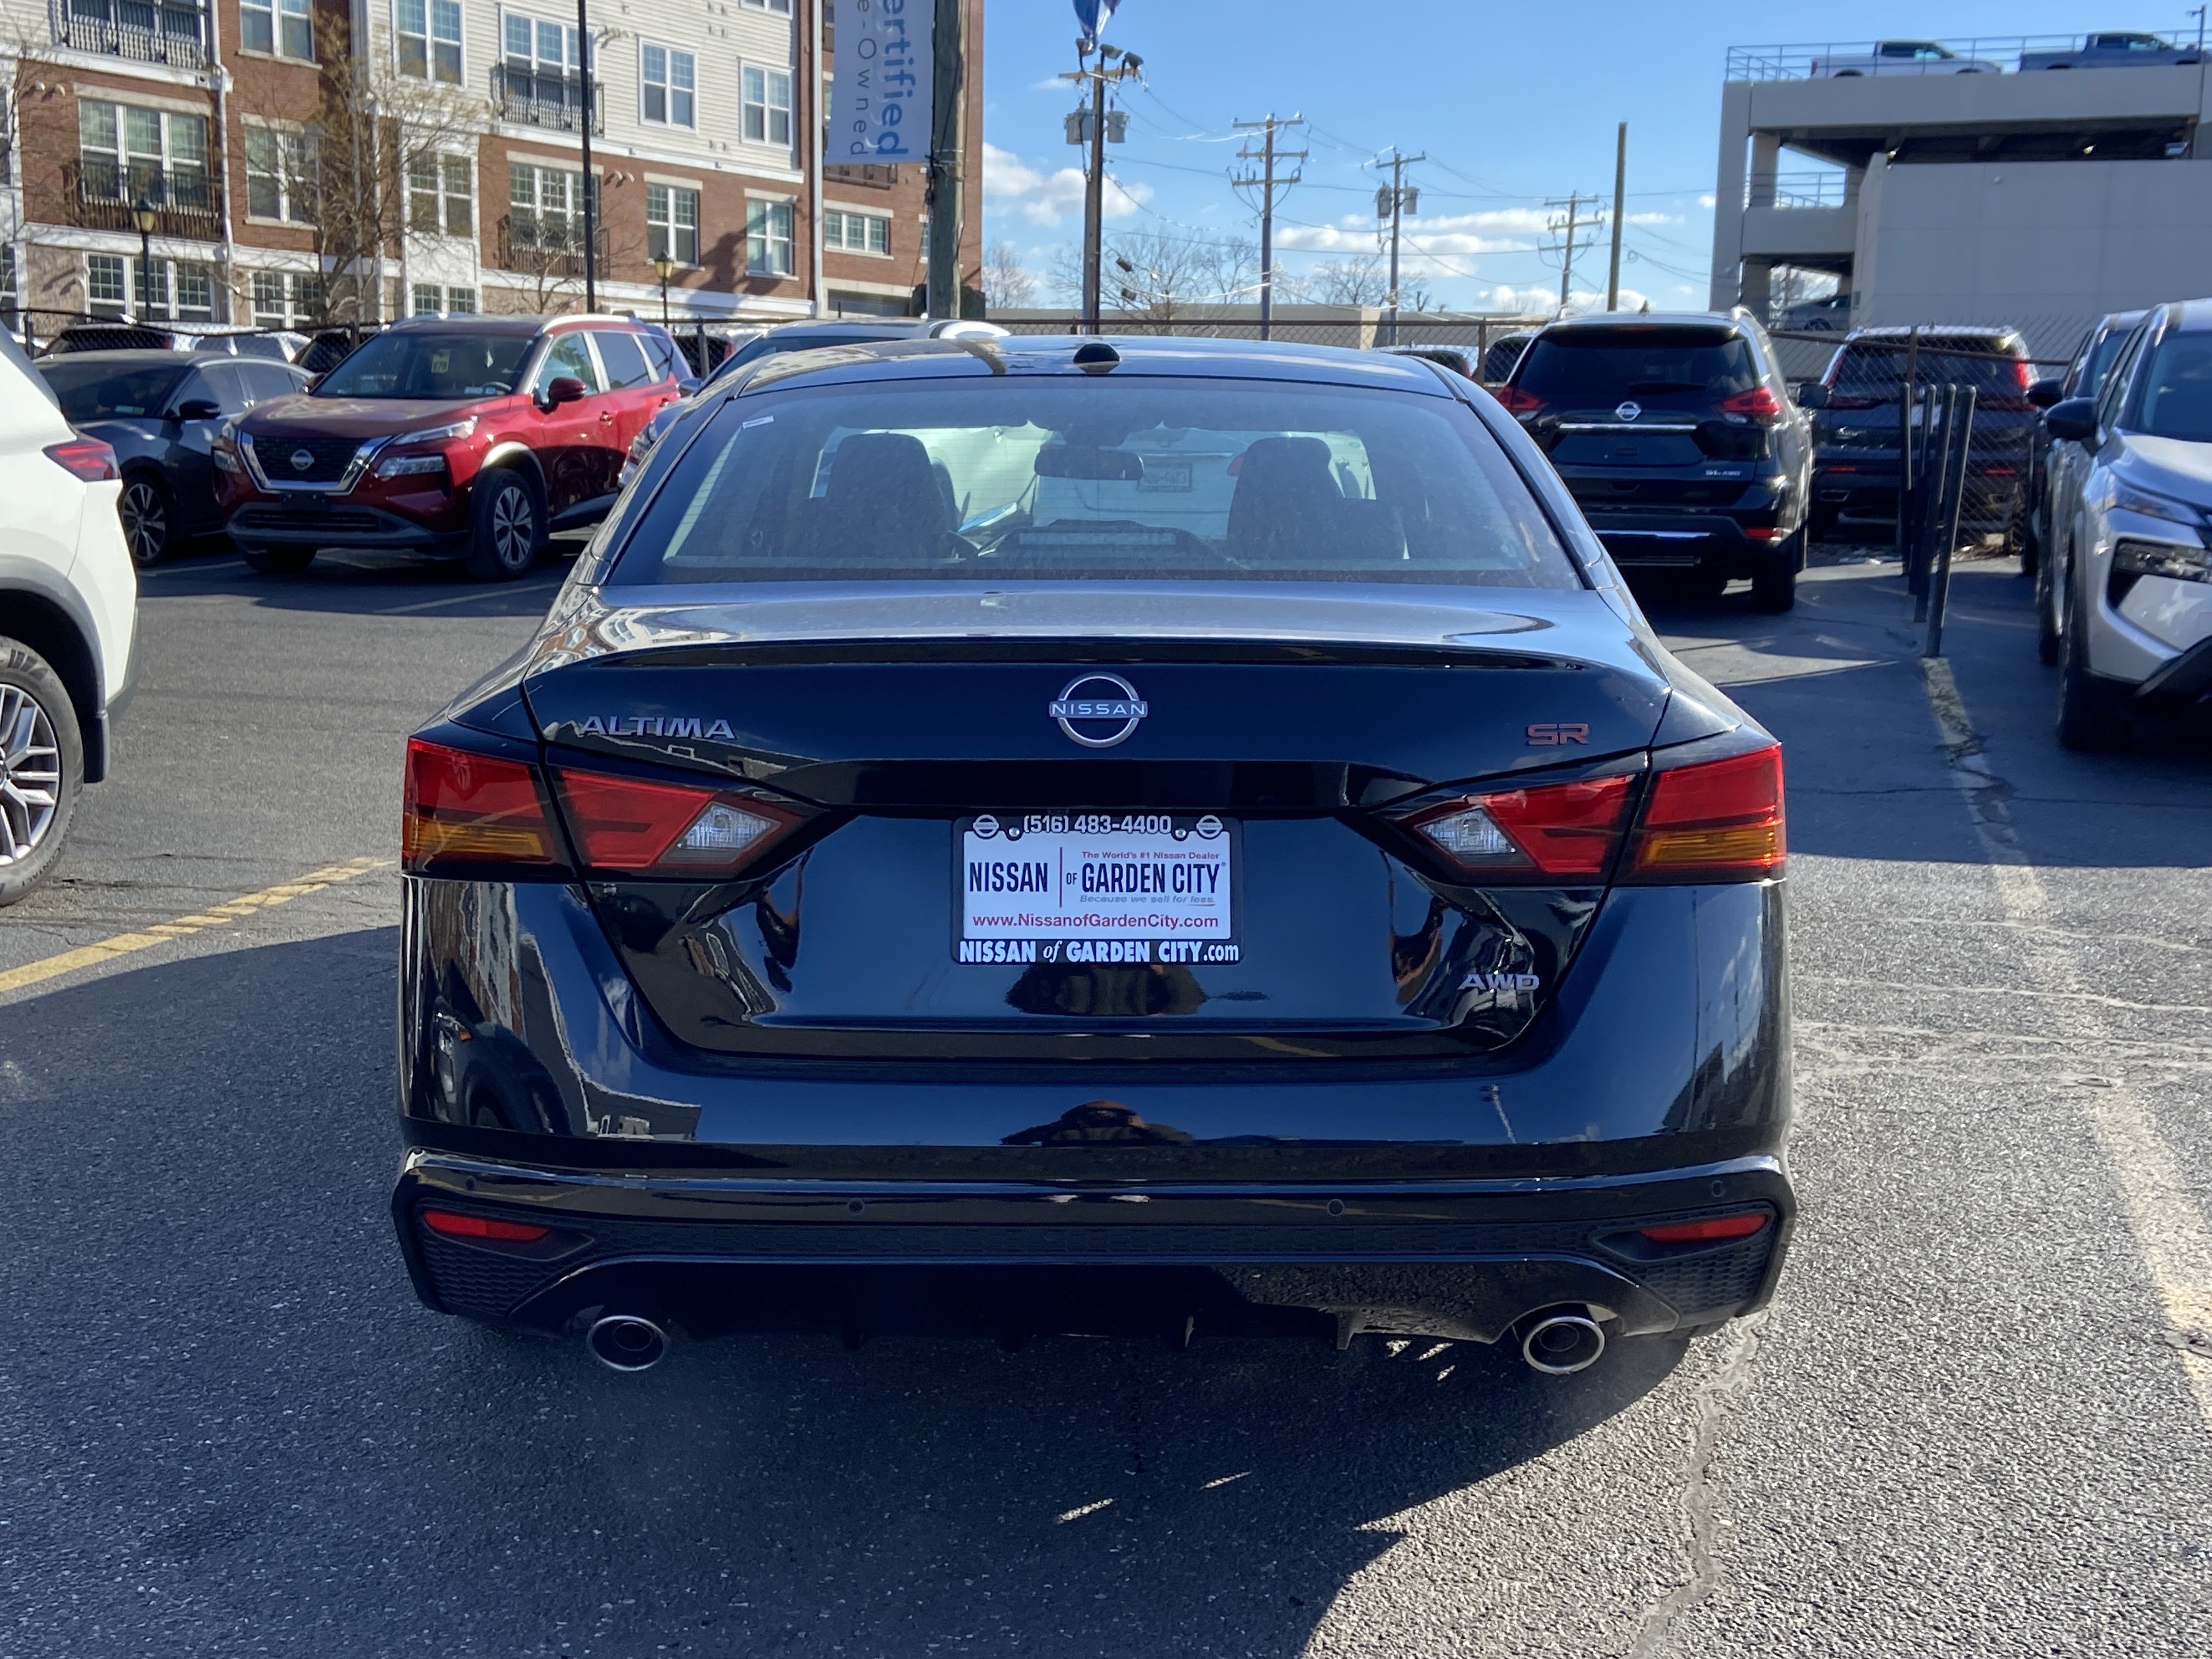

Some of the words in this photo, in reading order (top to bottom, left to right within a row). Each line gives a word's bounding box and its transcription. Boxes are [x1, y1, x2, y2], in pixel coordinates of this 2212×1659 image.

[1052, 704, 1144, 715] NISSAN
[582, 716, 737, 740] ALTIMA
[1527, 724, 1589, 746] SR
[1024, 816, 1069, 833] (516)
[1074, 815, 1172, 833] 483-4400
[969, 862, 1048, 892] NISSAN
[1066, 873, 1077, 885] OF
[1082, 863, 1165, 893] GARDEN
[1172, 864, 1219, 893] CITY
[973, 913, 1218, 929] www.NissanofGardenCity.com
[960, 941, 1036, 963] NISSAN
[1043, 941, 1063, 963] of
[1066, 942, 1150, 963] GARDEN
[1158, 942, 1239, 962] CITY.com
[1457, 974, 1539, 990] AWD
